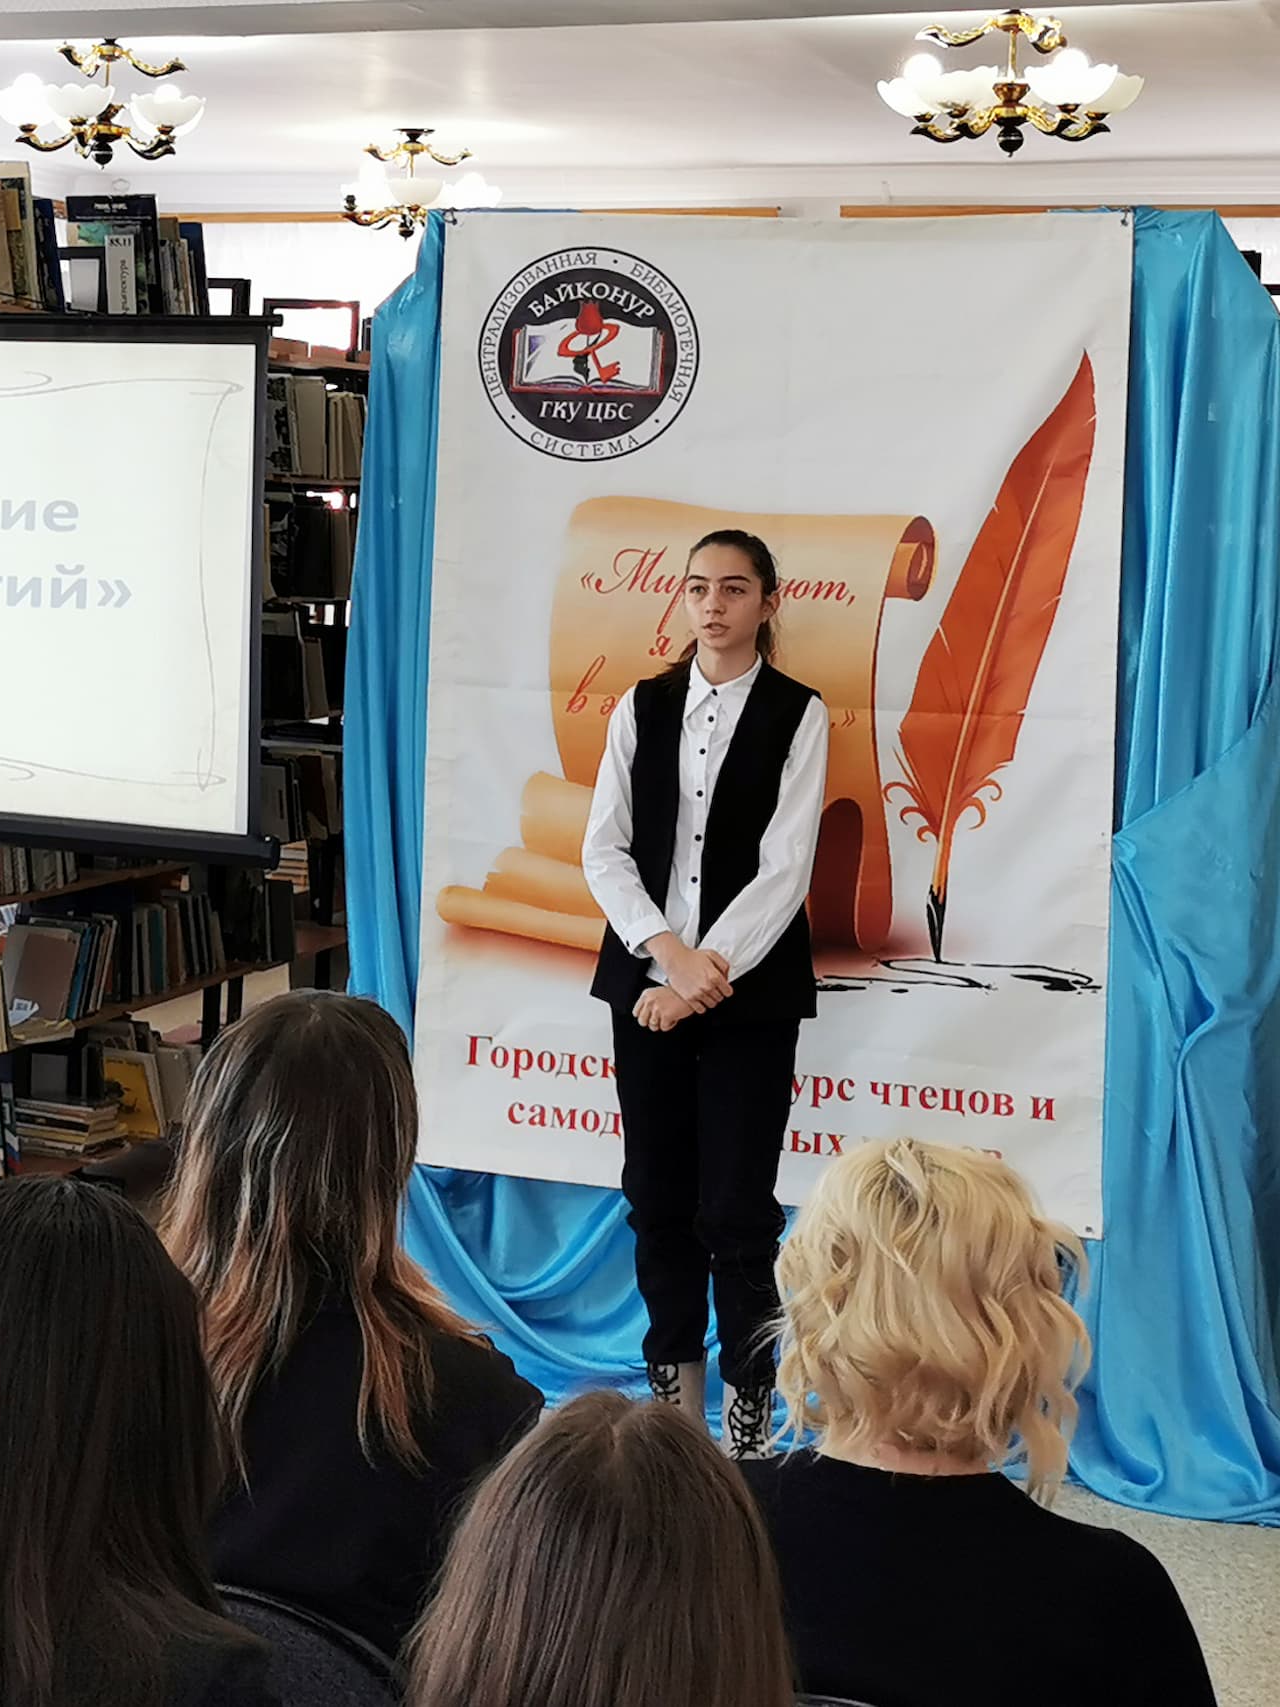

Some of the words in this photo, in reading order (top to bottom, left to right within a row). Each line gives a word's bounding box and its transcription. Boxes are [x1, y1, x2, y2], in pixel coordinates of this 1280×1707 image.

[120, 259, 131, 313] рхитектура
[527, 281, 656, 320] БАЙКОНУР
[482, 252, 598, 399] ЦЕНТРАЛИЗОВАННАЯ
[629, 263, 696, 403] БИБЛИОТЕЧНАЯ
[539, 401, 583, 423] ГКУ
[585, 402, 635, 423] ЦБС
[529, 430, 640, 458] СИСТЕМА
[649, 634, 673, 657] я
[465, 1034, 617, 1080] Городск
[869, 1080, 1015, 1117] чтецов
[1029, 1095, 1057, 1121] и
